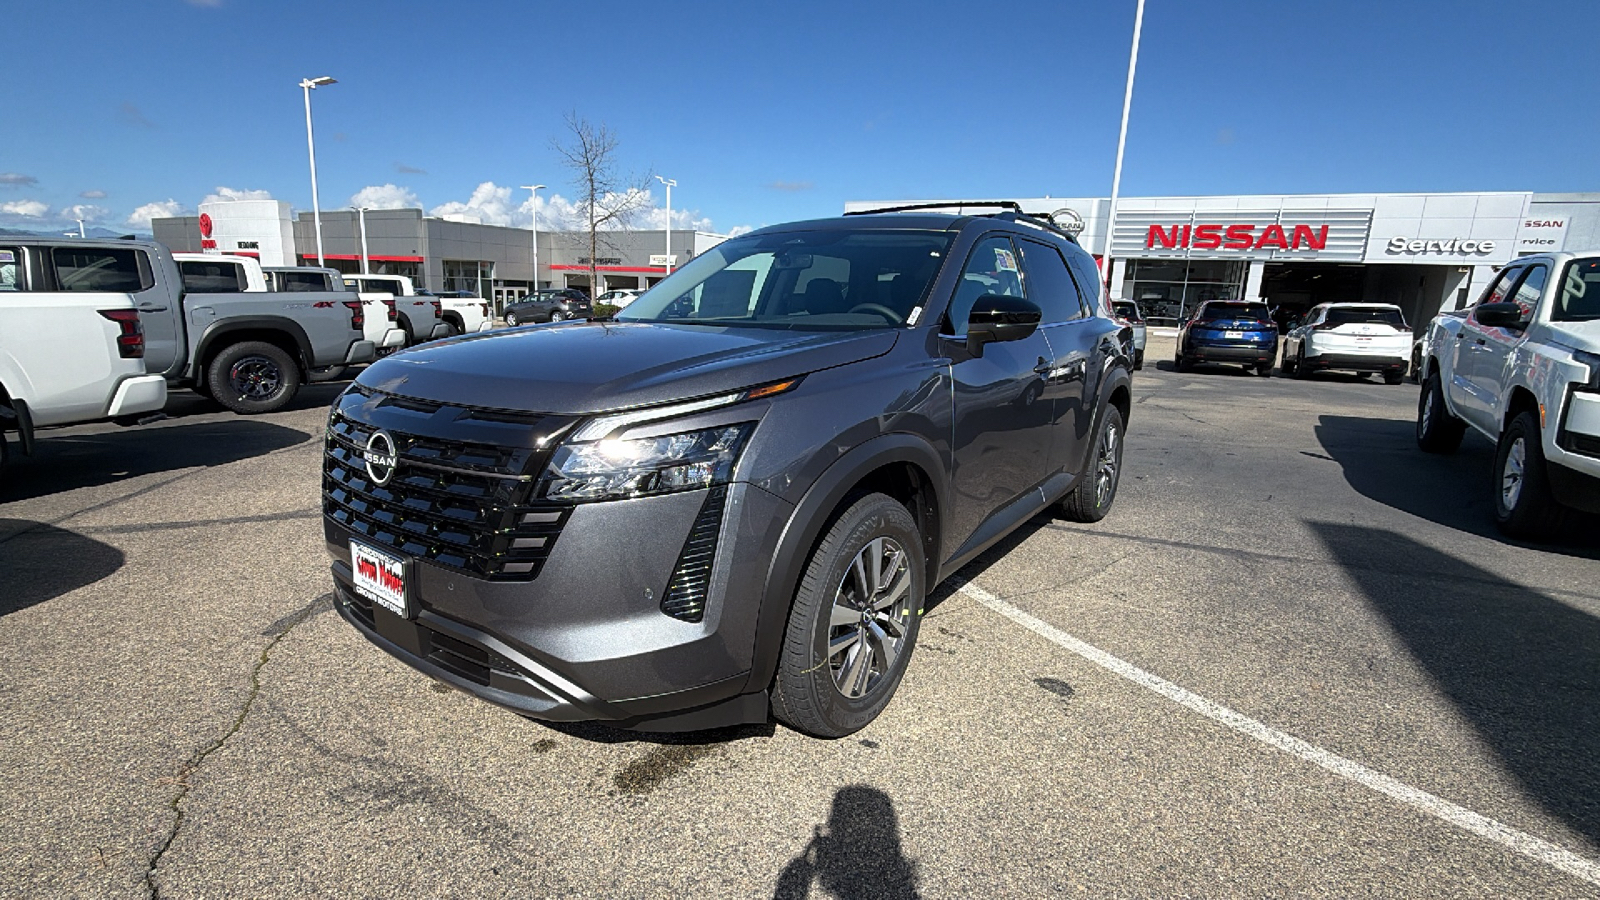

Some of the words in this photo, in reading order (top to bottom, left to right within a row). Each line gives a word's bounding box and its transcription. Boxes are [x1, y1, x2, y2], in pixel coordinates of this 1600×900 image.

[1524, 220, 1564, 228] SSAN
[1147, 224, 1329, 250] NISSAN
[1386, 236, 1497, 255] Service
[1520, 237, 1556, 245] rvice
[363, 450, 397, 468] NISSAN
